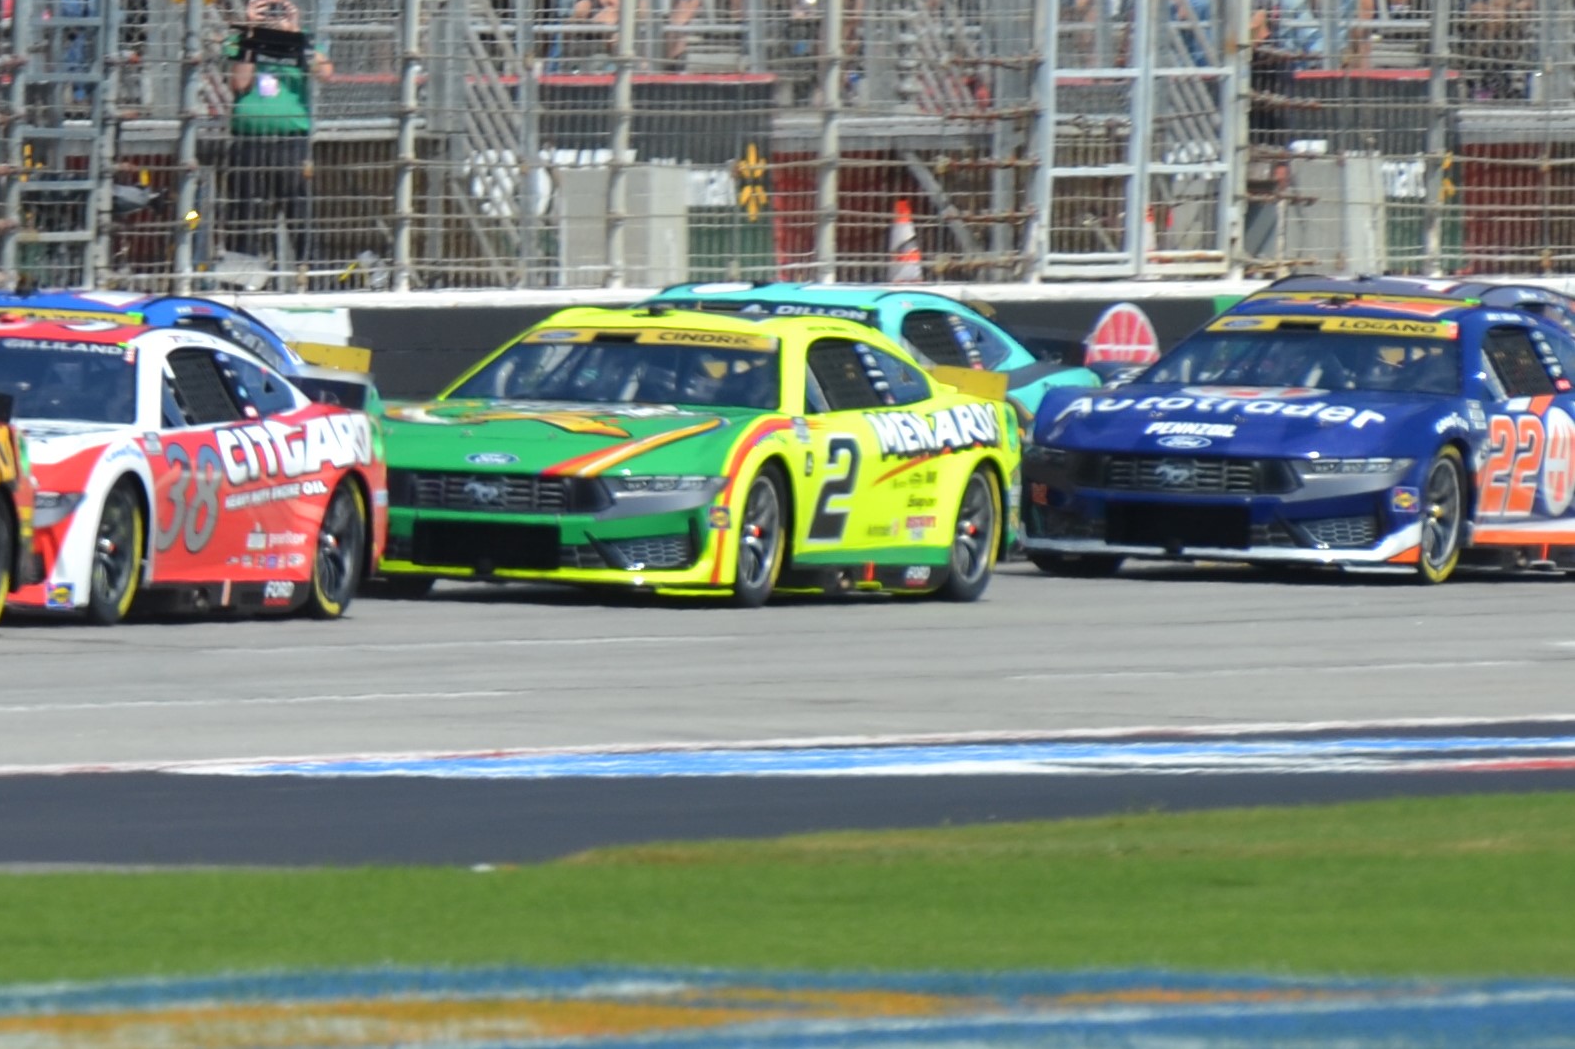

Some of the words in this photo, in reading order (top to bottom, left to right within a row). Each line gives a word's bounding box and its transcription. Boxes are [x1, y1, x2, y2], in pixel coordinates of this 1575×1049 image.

[774, 305, 868, 320] DILLON
[1338, 319, 1438, 335] LOGANO
[1, 338, 124, 355] GILLILAND
[1053, 396, 1386, 431] Autotrader
[1144, 421, 1238, 438] PENNZOIL
[215, 411, 372, 486] CITGARD
[1477, 413, 1548, 517] 22
[154, 441, 223, 555] 38
[302, 479, 329, 496] OIL
[806, 432, 862, 544] 2
